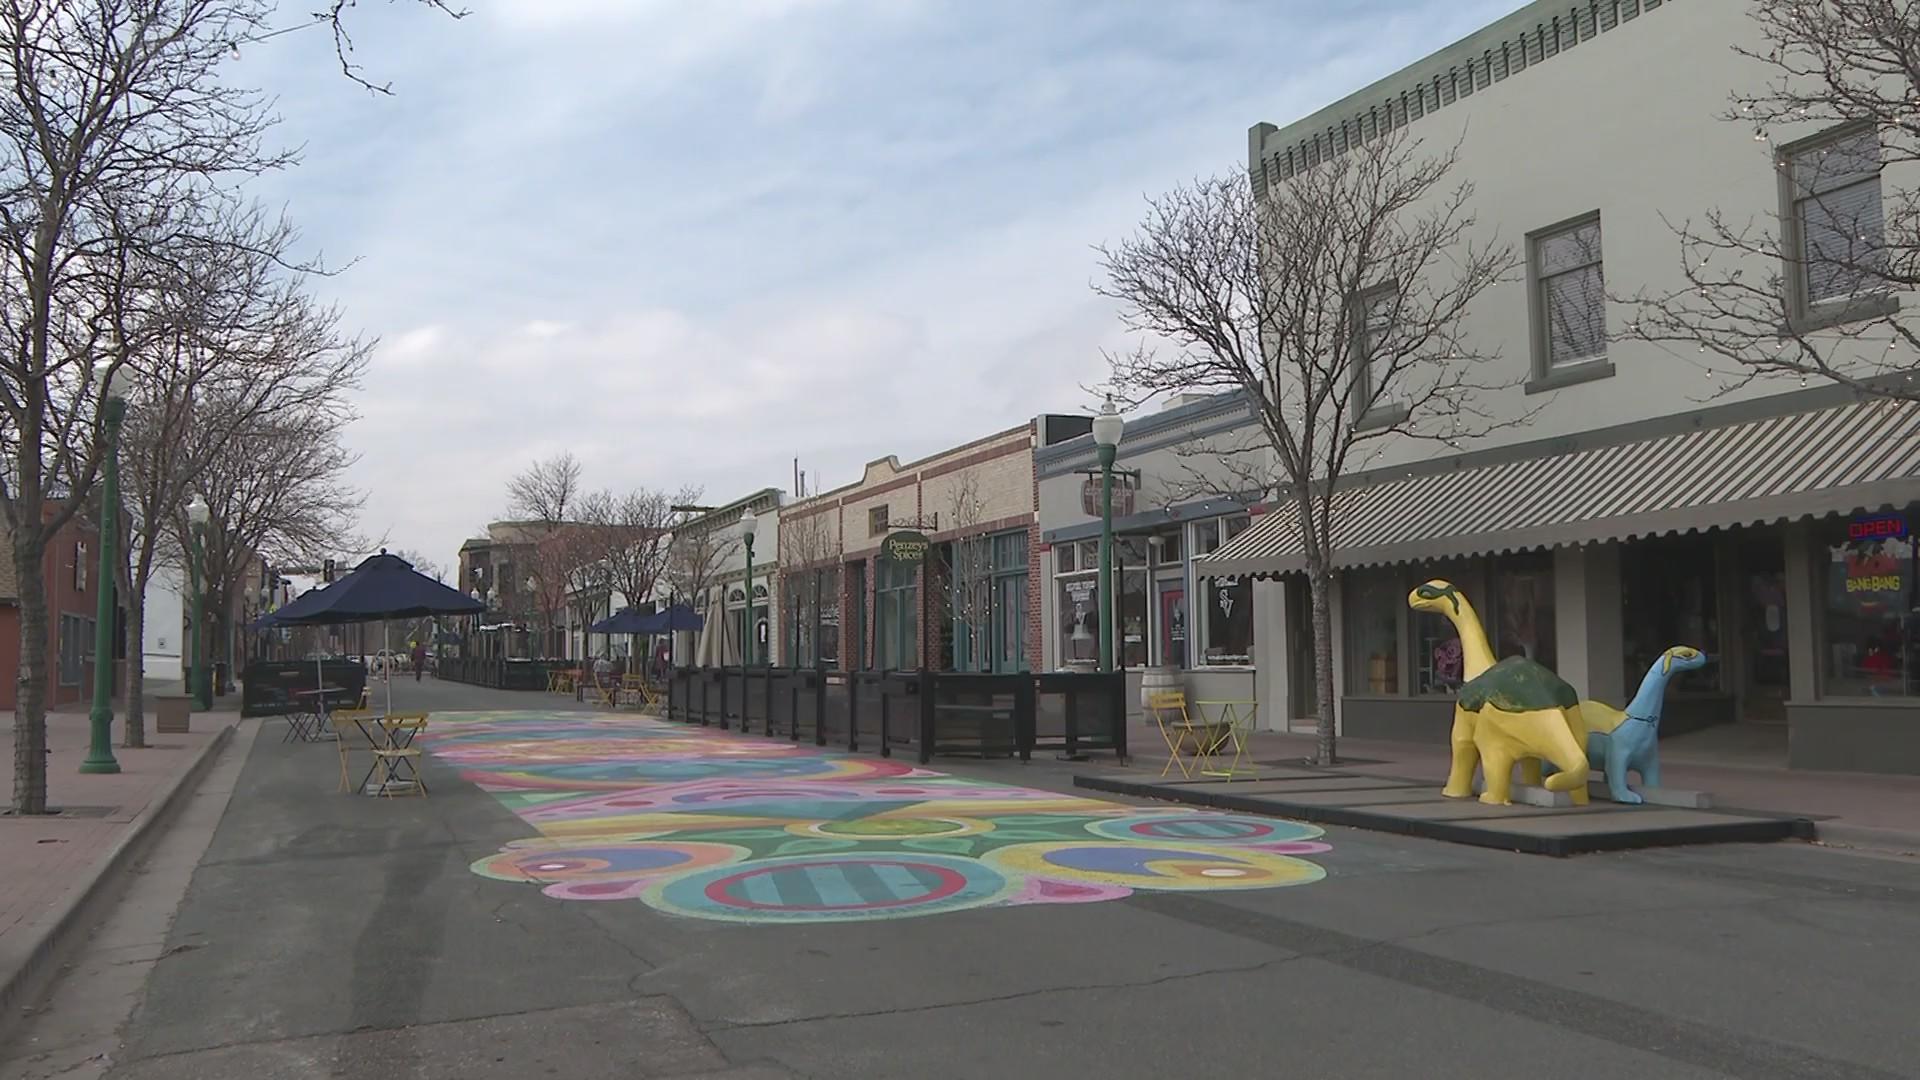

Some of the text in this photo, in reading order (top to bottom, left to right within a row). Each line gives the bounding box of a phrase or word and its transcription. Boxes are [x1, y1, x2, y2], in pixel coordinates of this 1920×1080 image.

[1848, 519, 1902, 537] OPEN
[1846, 576, 1900, 592] BANG BANG
